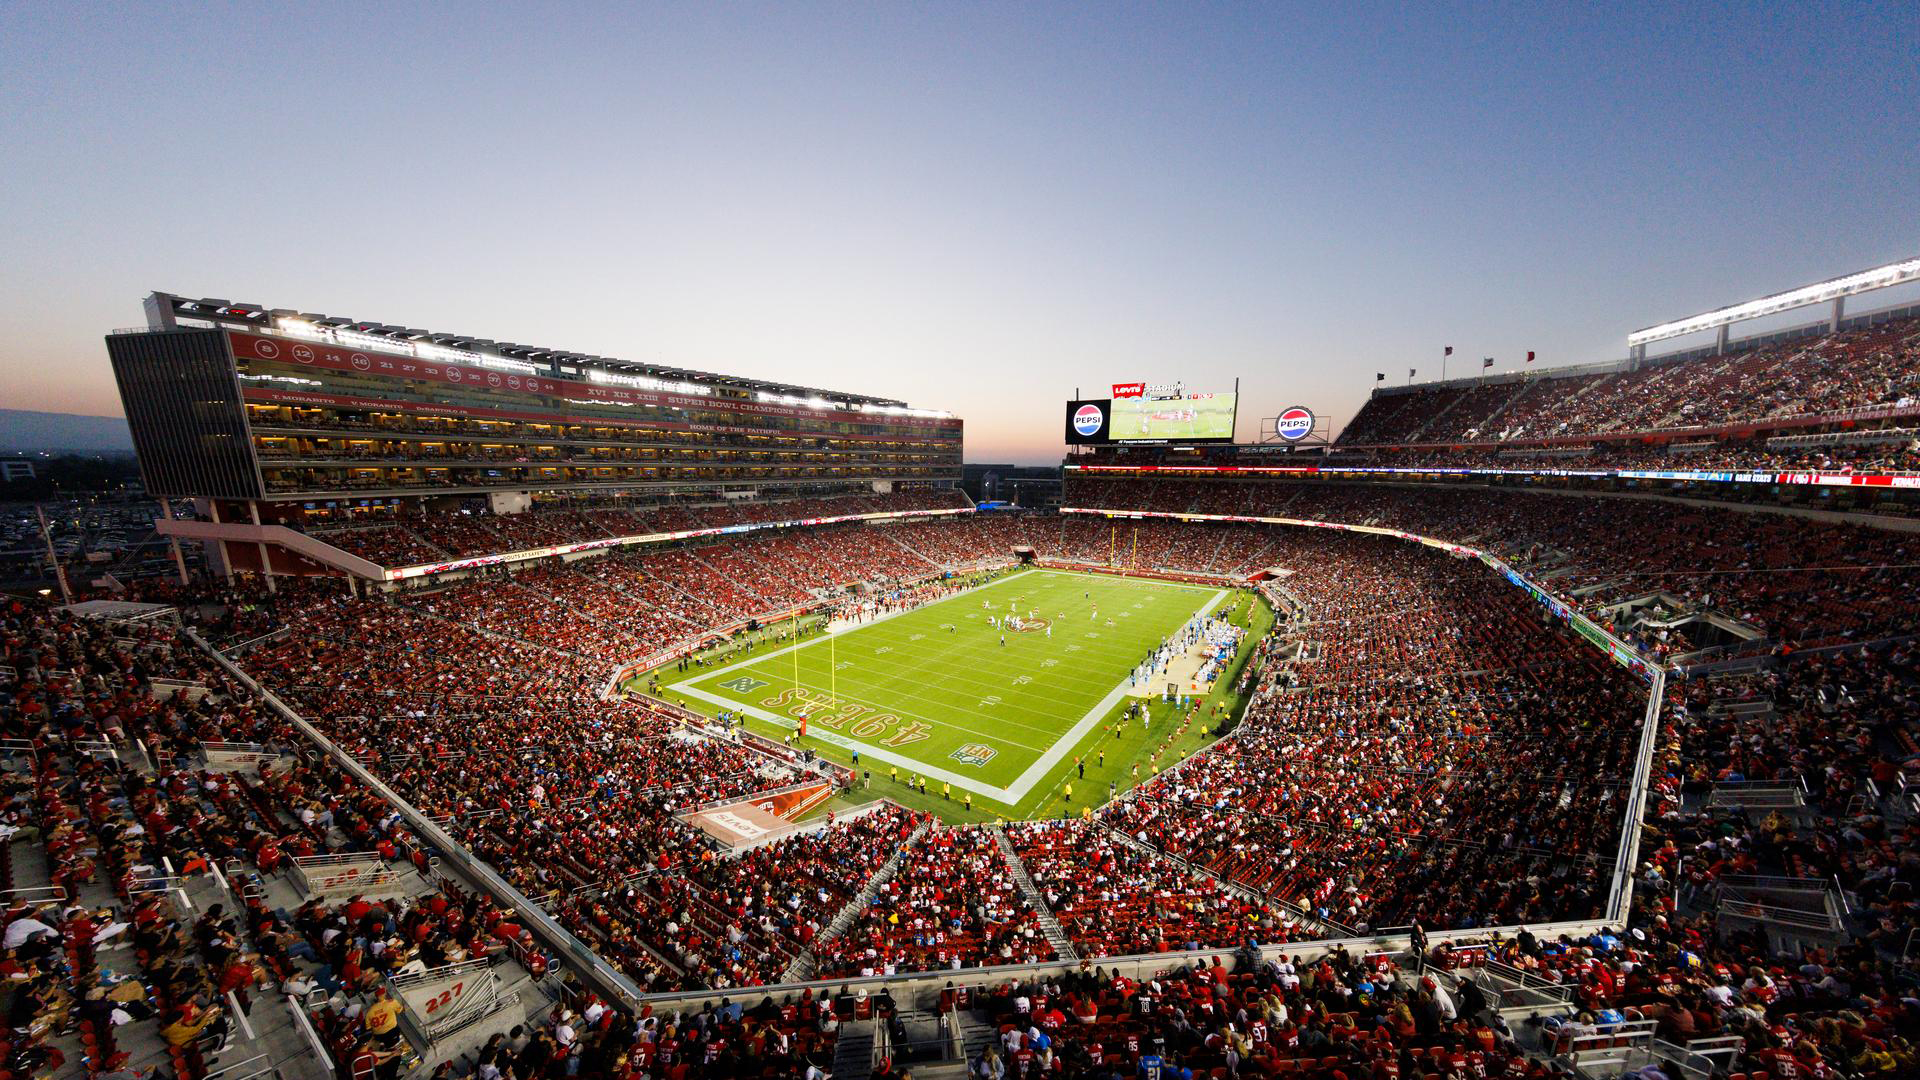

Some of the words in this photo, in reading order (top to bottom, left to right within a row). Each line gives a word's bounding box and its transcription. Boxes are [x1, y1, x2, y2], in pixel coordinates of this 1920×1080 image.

[295, 350, 312, 358] 12
[354, 356, 368, 366] 16
[282, 395, 336, 404] MORABITO
[668, 396, 706, 406] SUPER
[708, 400, 738, 410] BOWL
[740, 404, 794, 415] CHAMPIONS
[1854, 410, 1888, 420] SUPER
[1892, 405, 1920, 416] BOW
[1076, 416, 1101, 424] PEPSI
[646, 652, 676, 668] FAITHFUL
[979, 696, 1001, 707] 10
[426, 982, 463, 1014] 227
[370, 1013, 388, 1027] 87
[1253, 1026, 1267, 1042] 97
[634, 1054, 646, 1066] 97
[1777, 1061, 1796, 1076] 85
